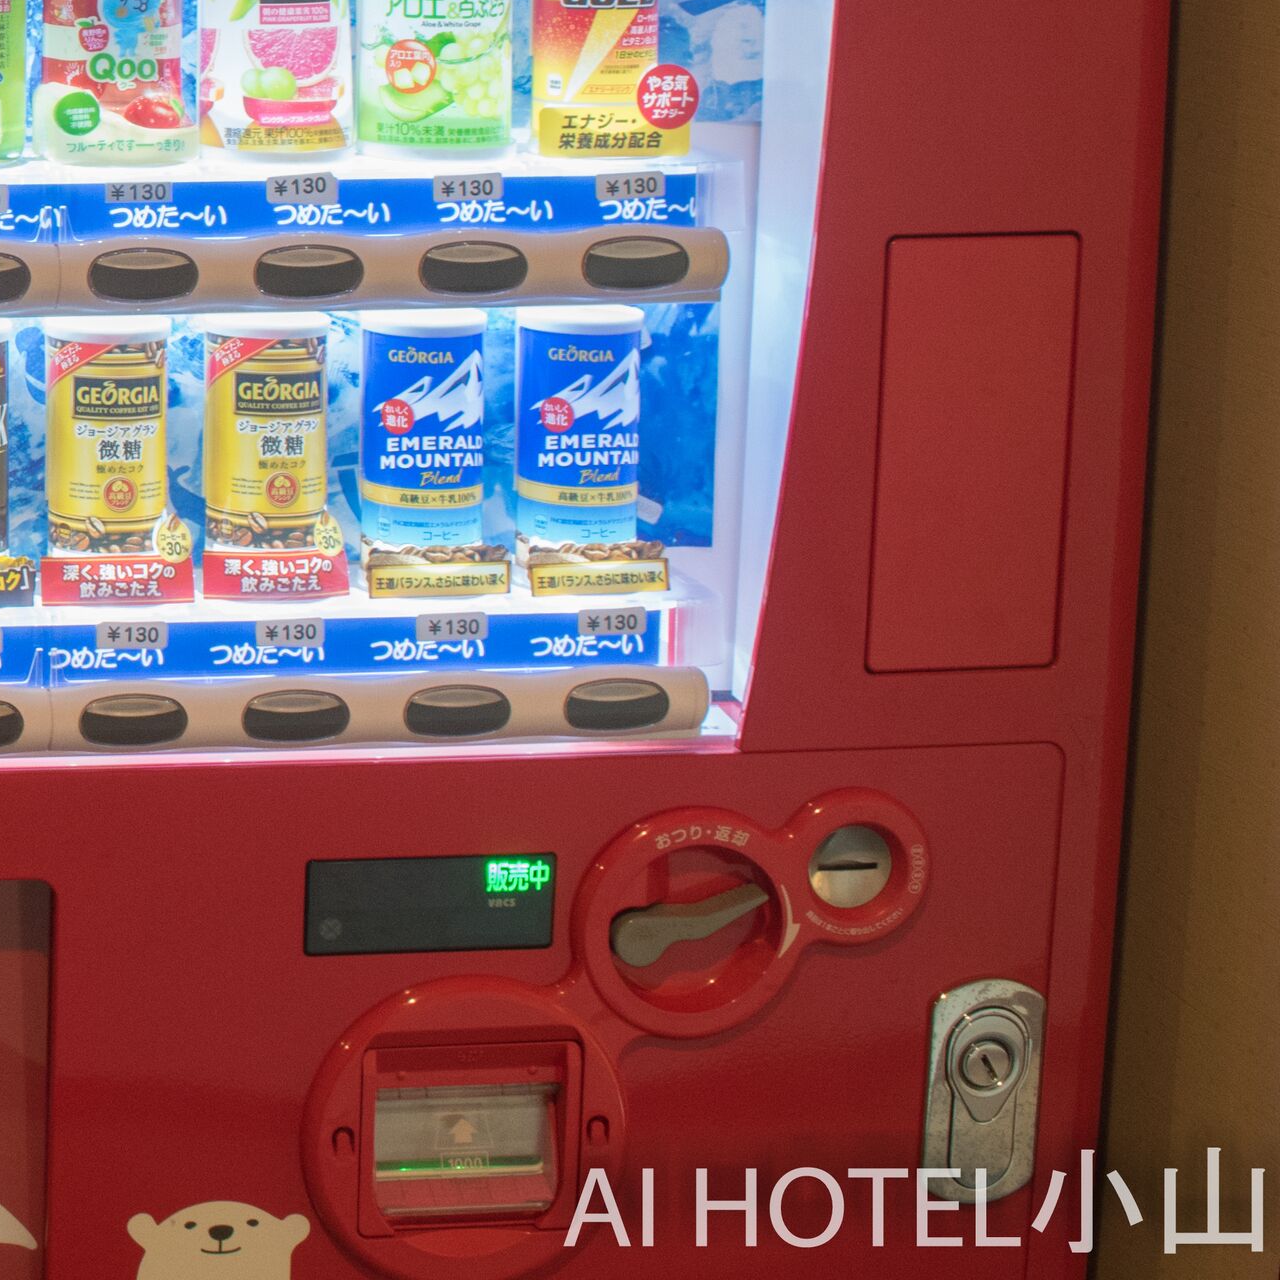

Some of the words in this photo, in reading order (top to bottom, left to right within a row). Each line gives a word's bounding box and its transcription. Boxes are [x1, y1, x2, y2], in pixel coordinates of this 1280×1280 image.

[89, 53, 157, 80] Qoo
[647, 74, 690, 91] やる気
[642, 90, 694, 108] サポート
[651, 109, 685, 119] エナジー
[559, 132, 662, 149] 栄養成分配合
[274, 177, 327, 195] ¥130
[441, 178, 493, 196] ¥130
[77, 381, 158, 405] GEORGIA
[239, 376, 319, 400] GEORGIA
[98, 439, 142, 461] 微糖
[260, 435, 304, 455] 微糖
[386, 435, 483, 452] EMERALD
[545, 432, 639, 450] EMERALD
[419, 468, 463, 487] Blend
[579, 467, 620, 484] Blend
[63, 563, 175, 581] 深く、強いコクの
[224, 557, 332, 576] 深く、強いコクの
[80, 581, 162, 598] 飲みごたえ
[241, 576, 322, 593] 飲みごたえ
[585, 613, 639, 631] ¥130
[107, 626, 160, 644] ¥130
[265, 624, 317, 641] ¥130
[654, 825, 750, 850] おつり・返却
[485, 861, 551, 894] 販売中
